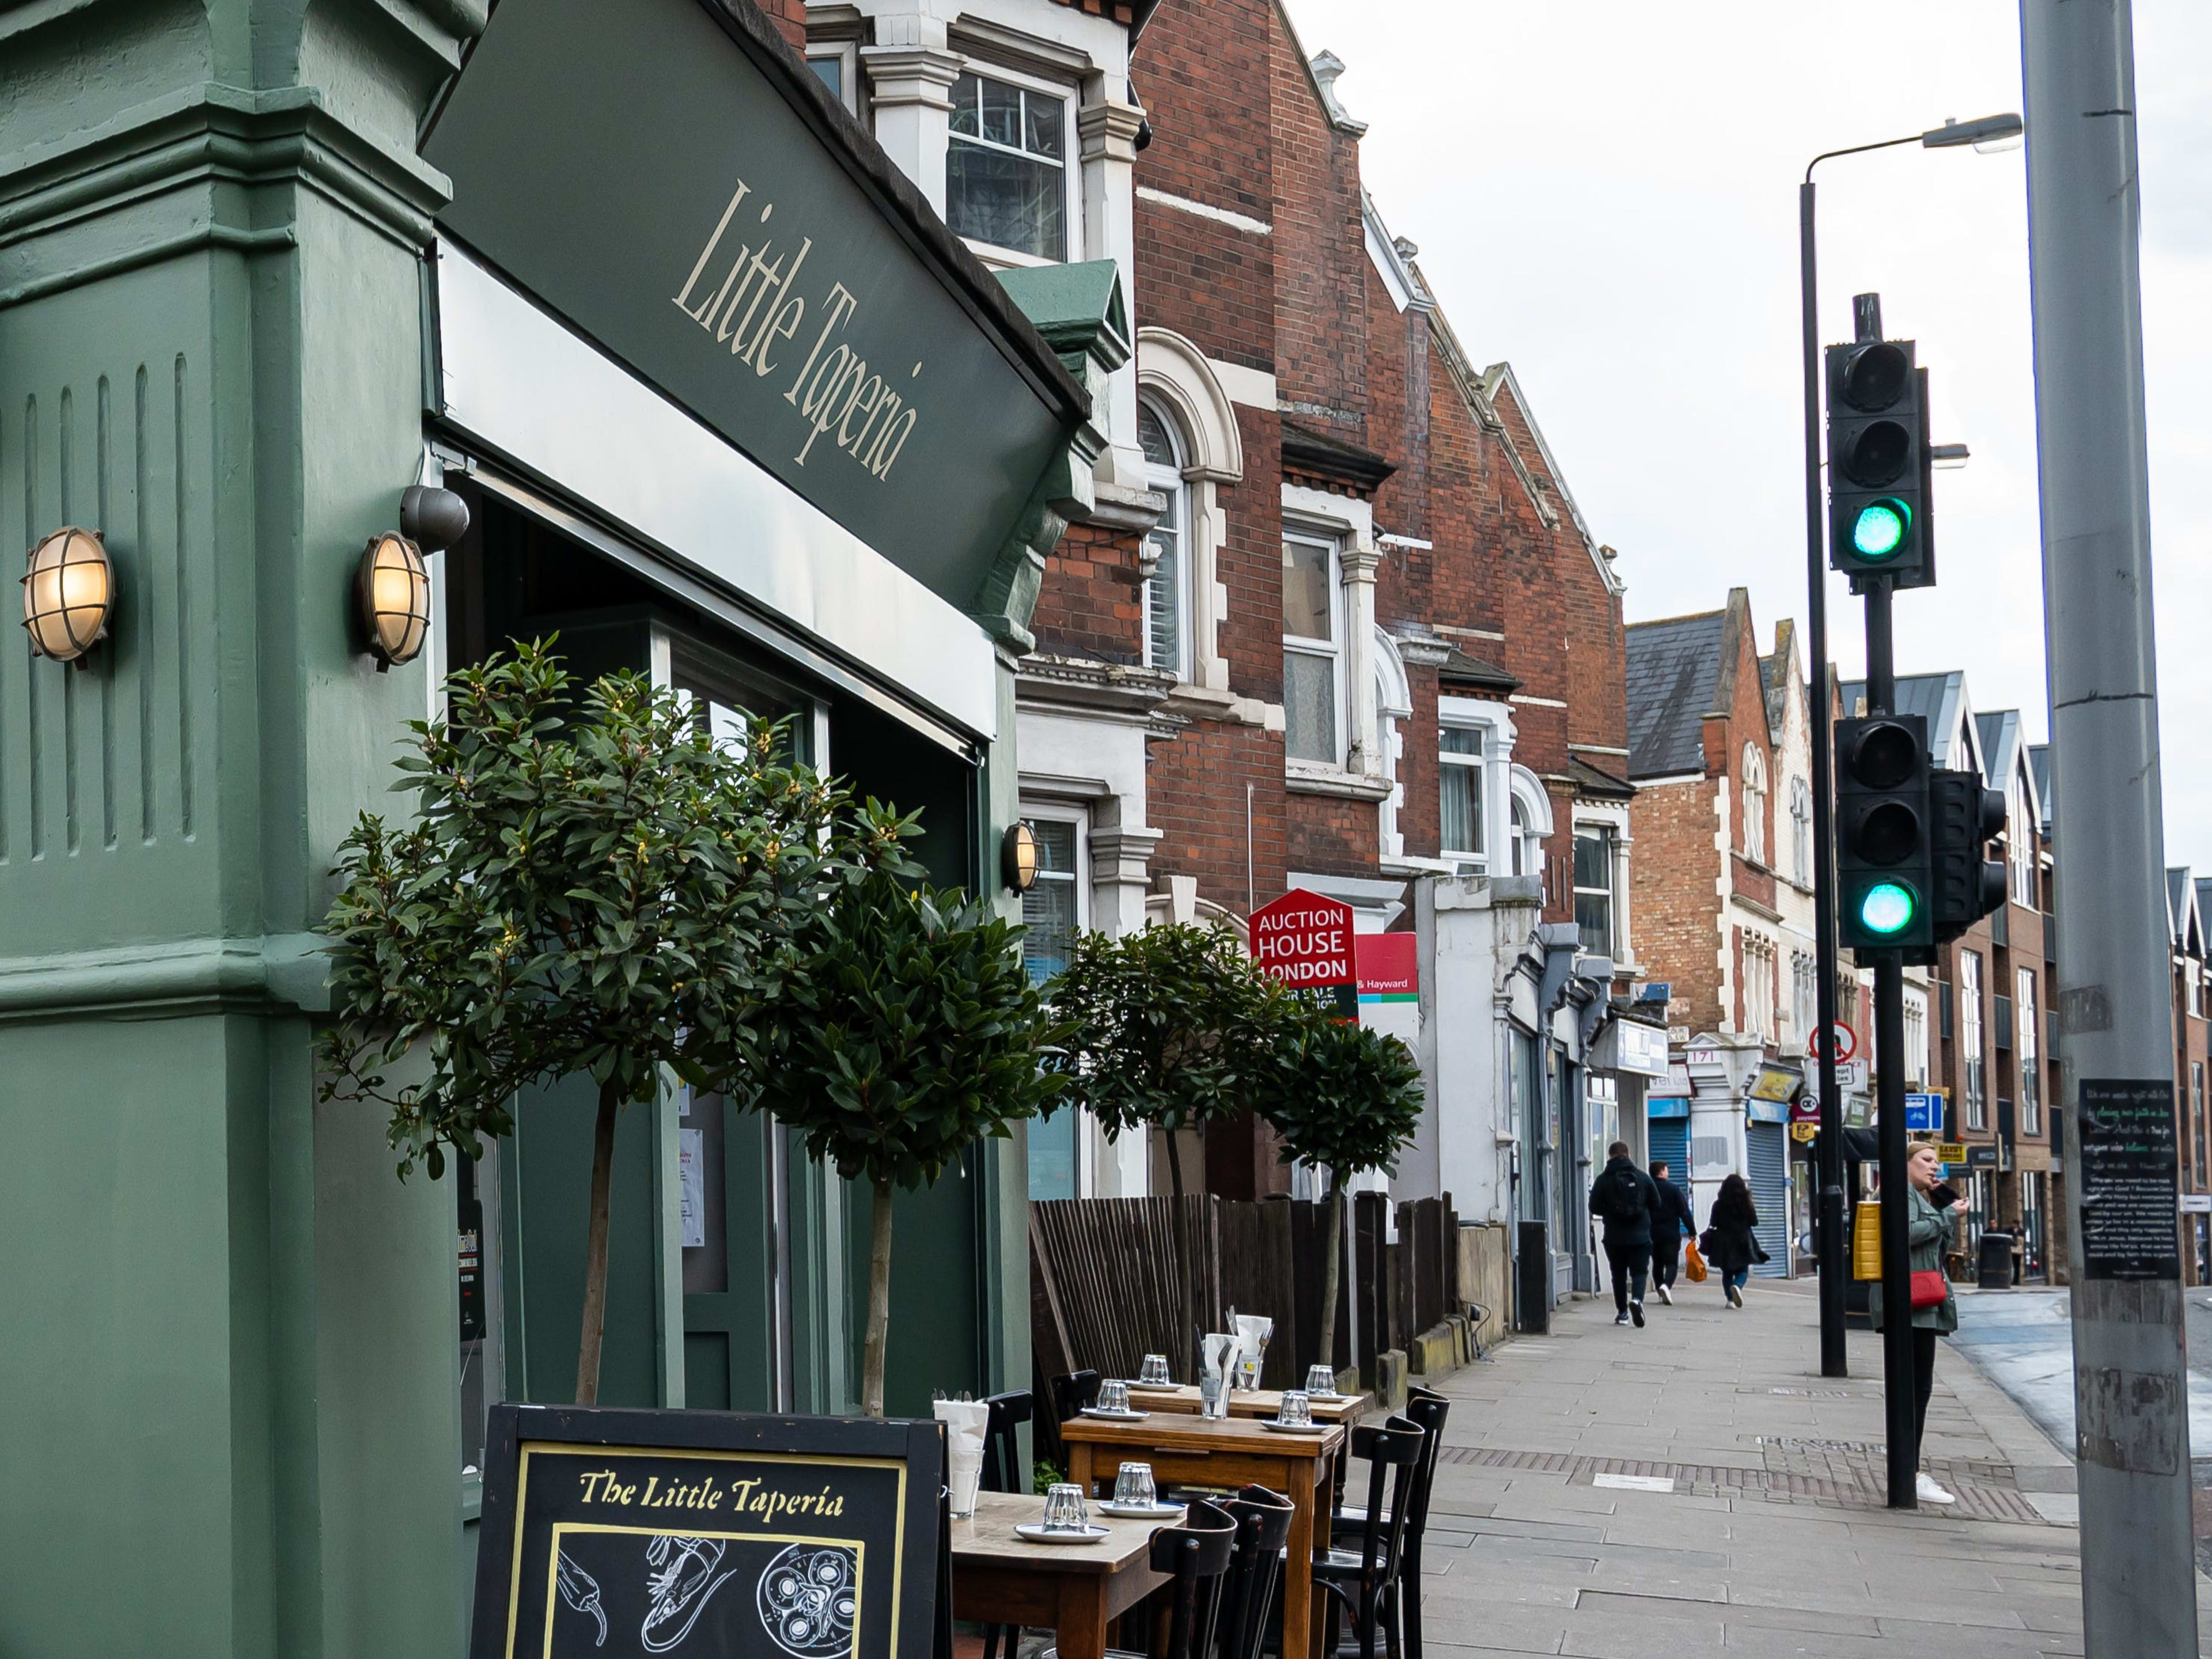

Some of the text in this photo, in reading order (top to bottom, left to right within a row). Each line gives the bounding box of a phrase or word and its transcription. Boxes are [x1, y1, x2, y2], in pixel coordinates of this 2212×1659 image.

[671, 177, 812, 377] Little
[1258, 908, 1344, 932] AUCTION
[1258, 930, 1346, 959] HOUSE
[1260, 959, 1347, 983] LONDON
[1367, 979, 1408, 990] Hayward
[1693, 1050, 1714, 1062] 171
[580, 1469, 844, 1524] The Little Tapería
